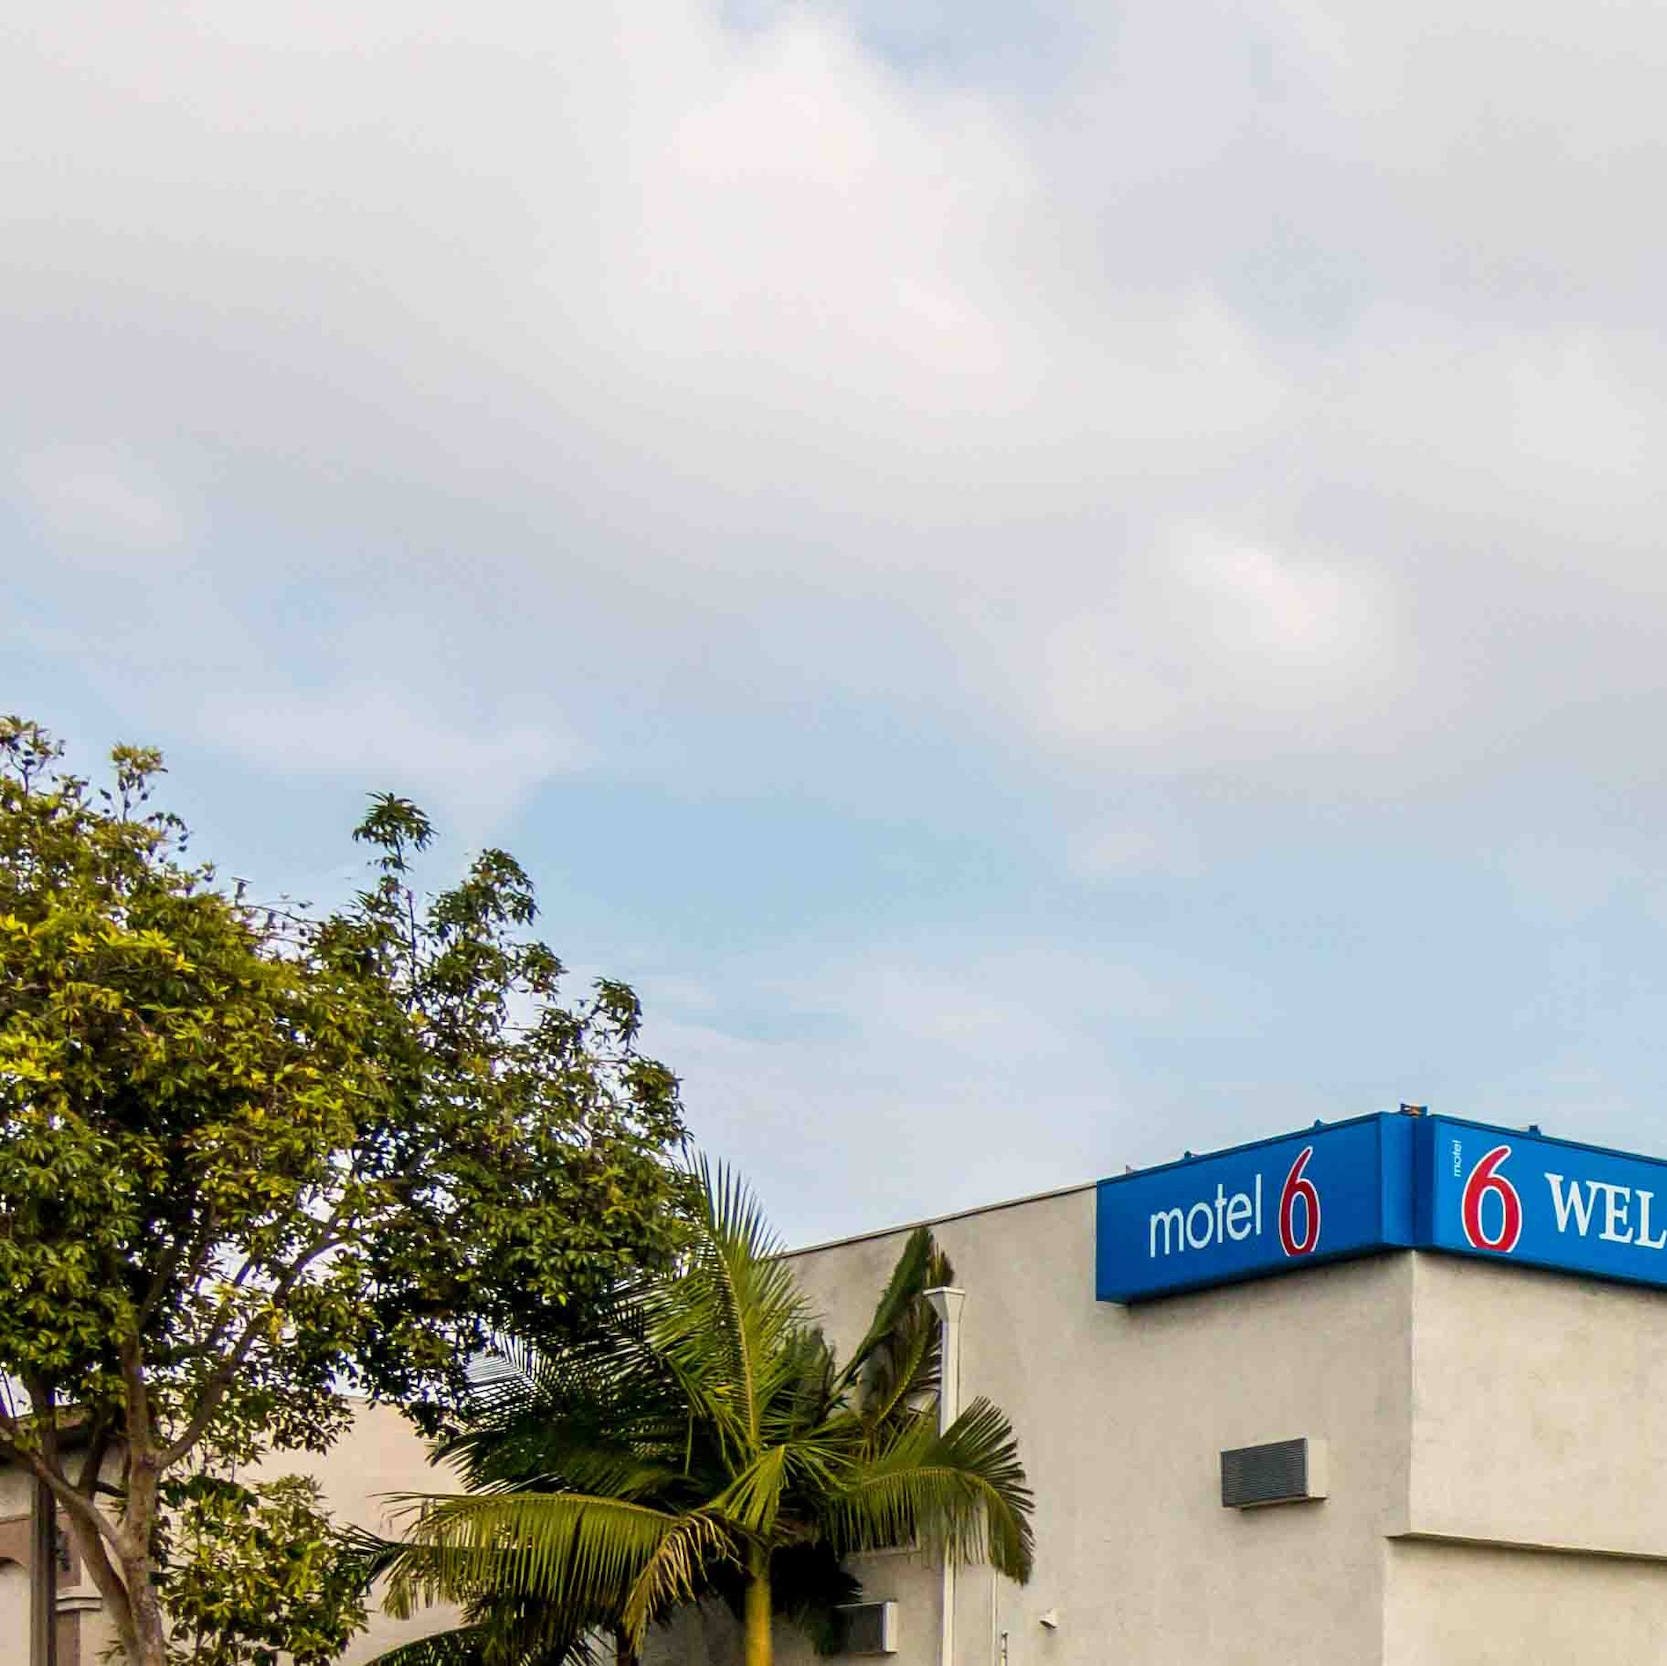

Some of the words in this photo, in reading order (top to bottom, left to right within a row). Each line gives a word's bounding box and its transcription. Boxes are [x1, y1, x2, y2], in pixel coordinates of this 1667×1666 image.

[1150, 1173, 1262, 1258] motel
[1278, 1145, 1321, 1257] 6
[1452, 1139, 1463, 1177] motel
[1461, 1144, 1523, 1253] 6
